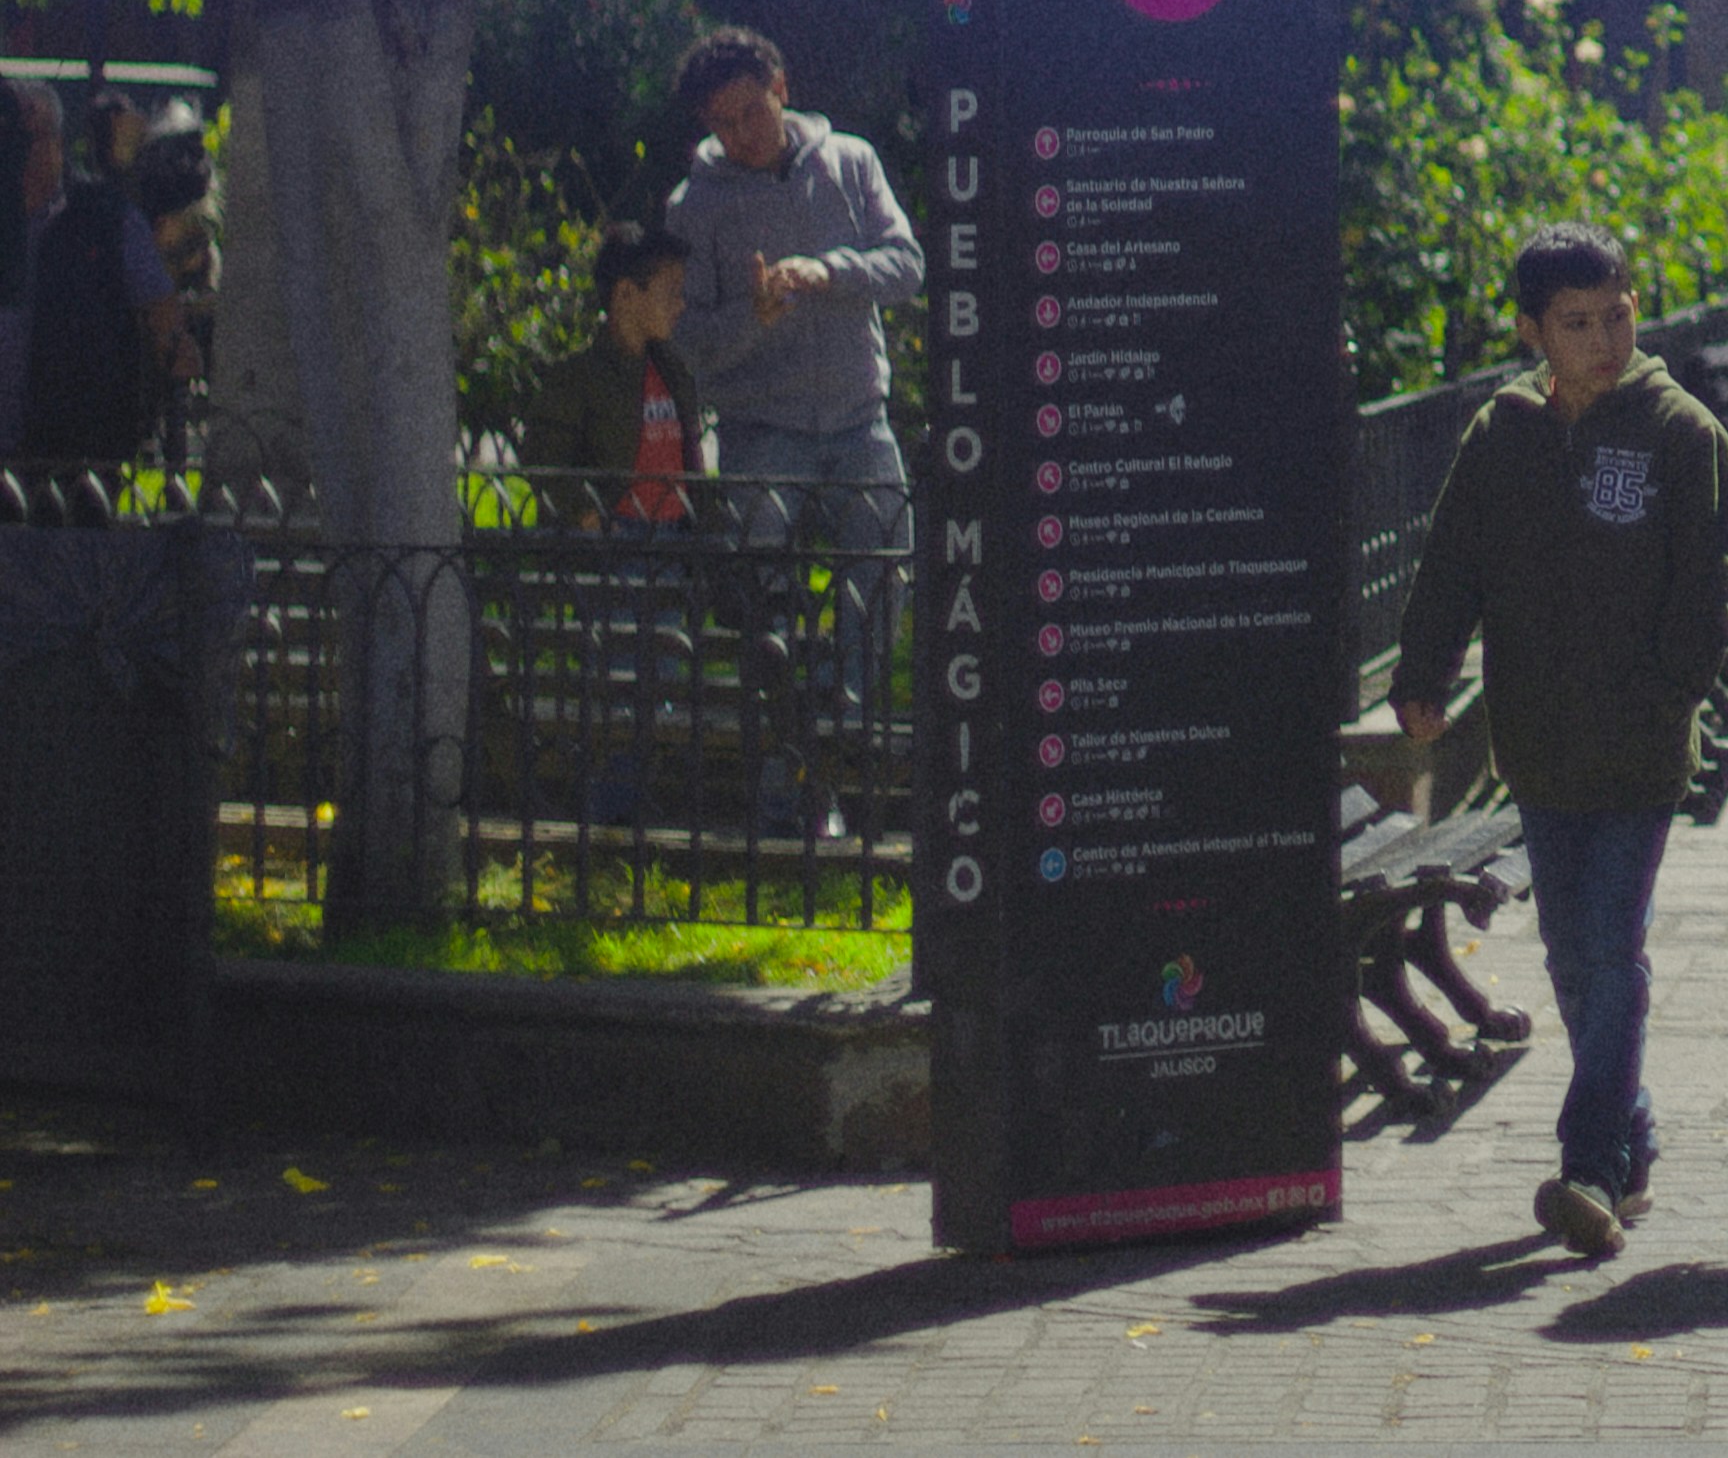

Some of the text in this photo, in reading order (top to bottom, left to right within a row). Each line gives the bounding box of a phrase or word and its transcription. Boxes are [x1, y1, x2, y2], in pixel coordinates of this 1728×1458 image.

[1066, 125, 1214, 144] Parroquia de San Pedro
[1066, 174, 1245, 192] Santuario de Nuestra Señora
[1066, 196, 1152, 212] de la Soledad
[1066, 240, 1180, 255] Casa del Artesano
[946, 89, 982, 473] PUEBLO
[1067, 292, 1218, 310] Andador Independencia
[1068, 349, 1160, 366] Jardín Hidalgo
[1069, 403, 1123, 418] El Parián
[1068, 454, 1232, 474] Centro Cultural El Refugio
[1593, 466, 1646, 513] 85
[1070, 508, 1264, 529] Museo Regional de la Cerámica
[1070, 559, 1307, 583] Presidencia Municipal de Tlaquepaque
[1070, 612, 1311, 638] Museo Premio Nacional de la Cerámica
[1070, 678, 1128, 693] Pila Seca
[1071, 725, 1230, 748] Taller de Nuestros Dulces
[1071, 788, 1162, 807] Casa Histórica
[1073, 846, 1117, 862] Centro
[1121, 844, 1138, 858] de
[1142, 840, 1200, 856] Atención
[1257, 832, 1268, 847] al
[1272, 831, 1315, 846] Turista
[1149, 1055, 1216, 1079] JALISCO
